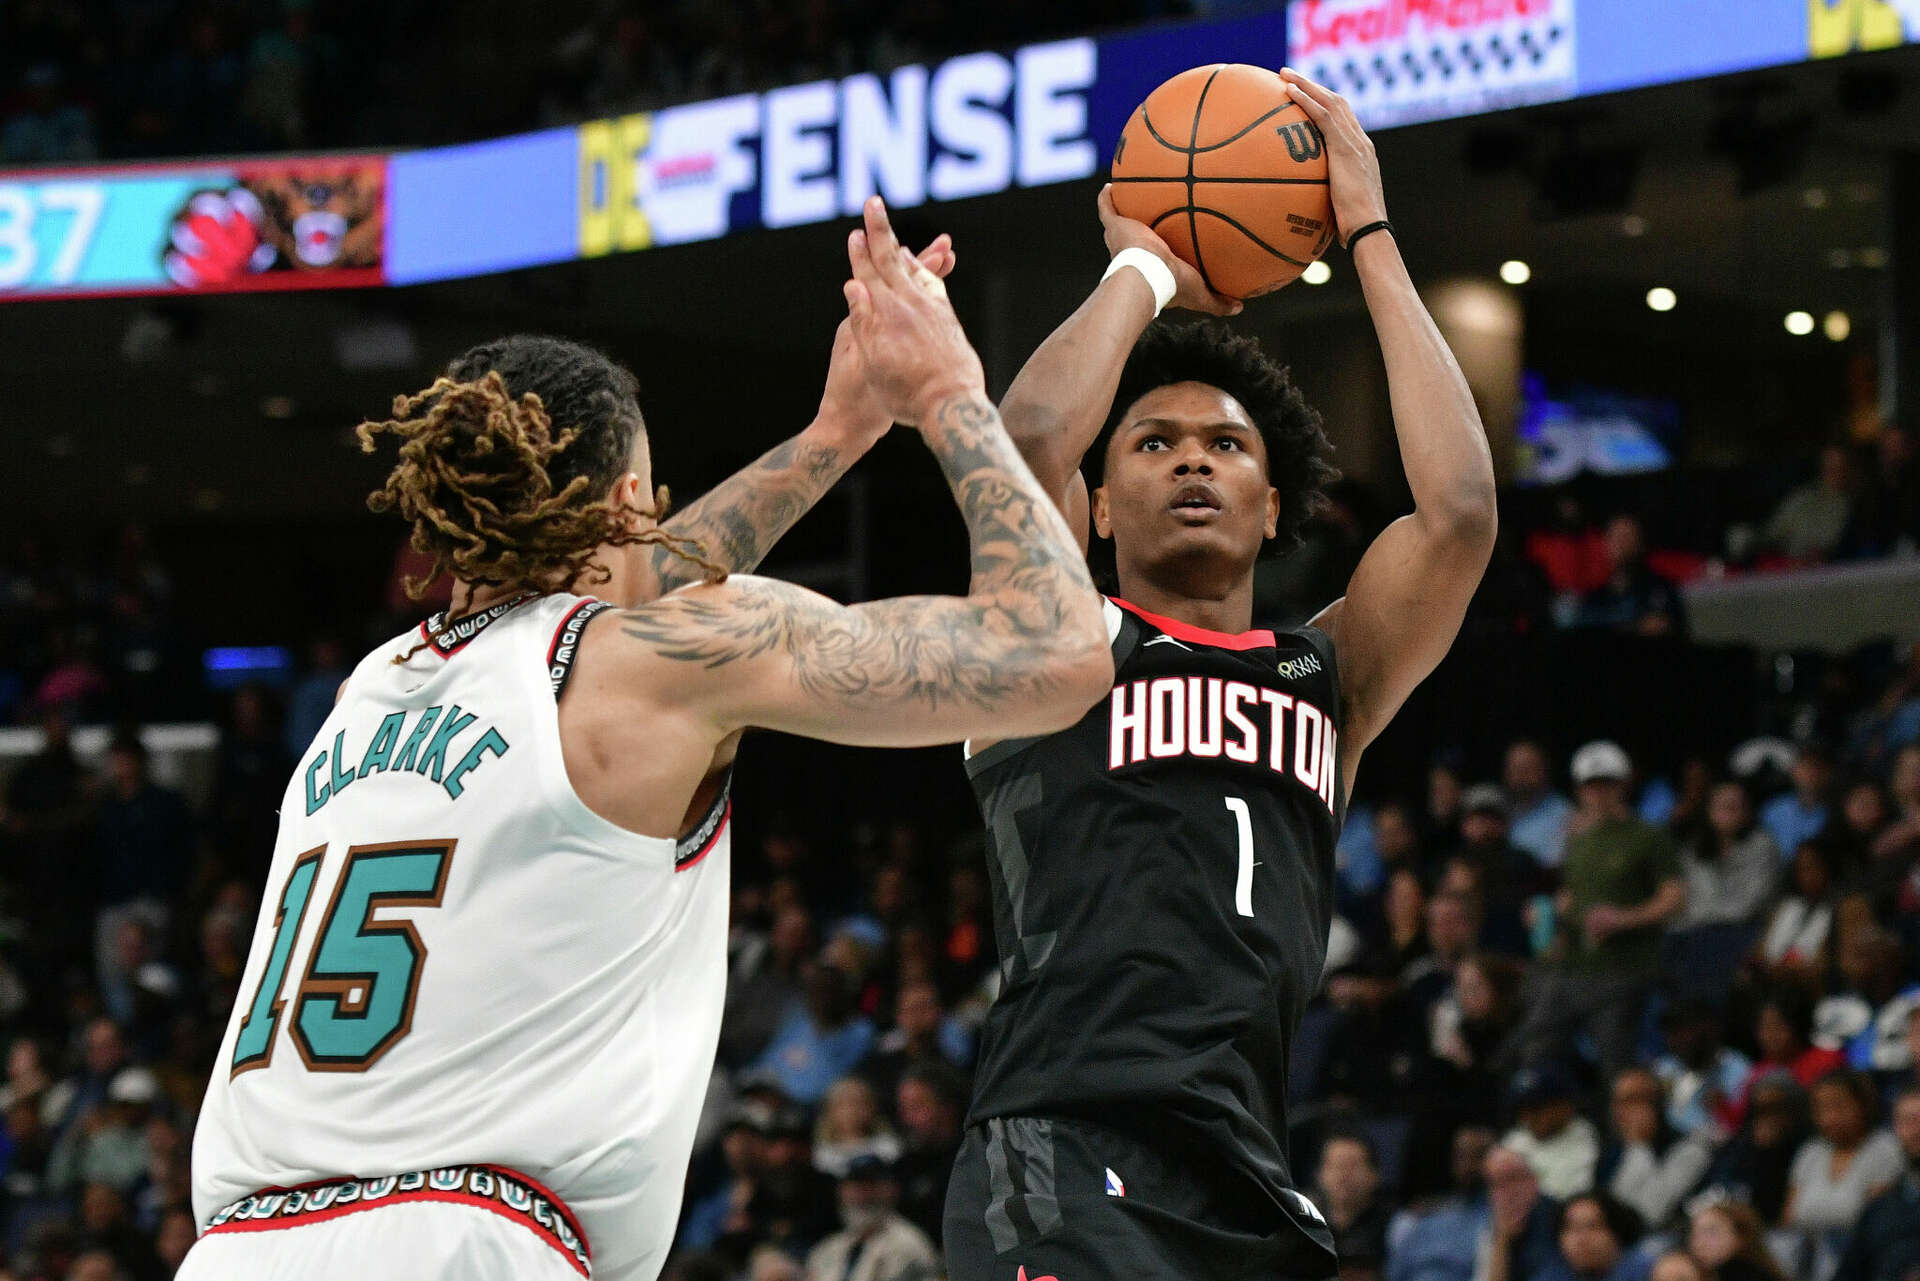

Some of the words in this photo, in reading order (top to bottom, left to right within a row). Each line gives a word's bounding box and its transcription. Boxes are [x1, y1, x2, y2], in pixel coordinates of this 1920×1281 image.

[306, 705, 509, 817] CLARKE
[1109, 676, 1338, 816] HOUSTON
[1225, 796, 1254, 917] 1
[230, 838, 459, 1084] 15
